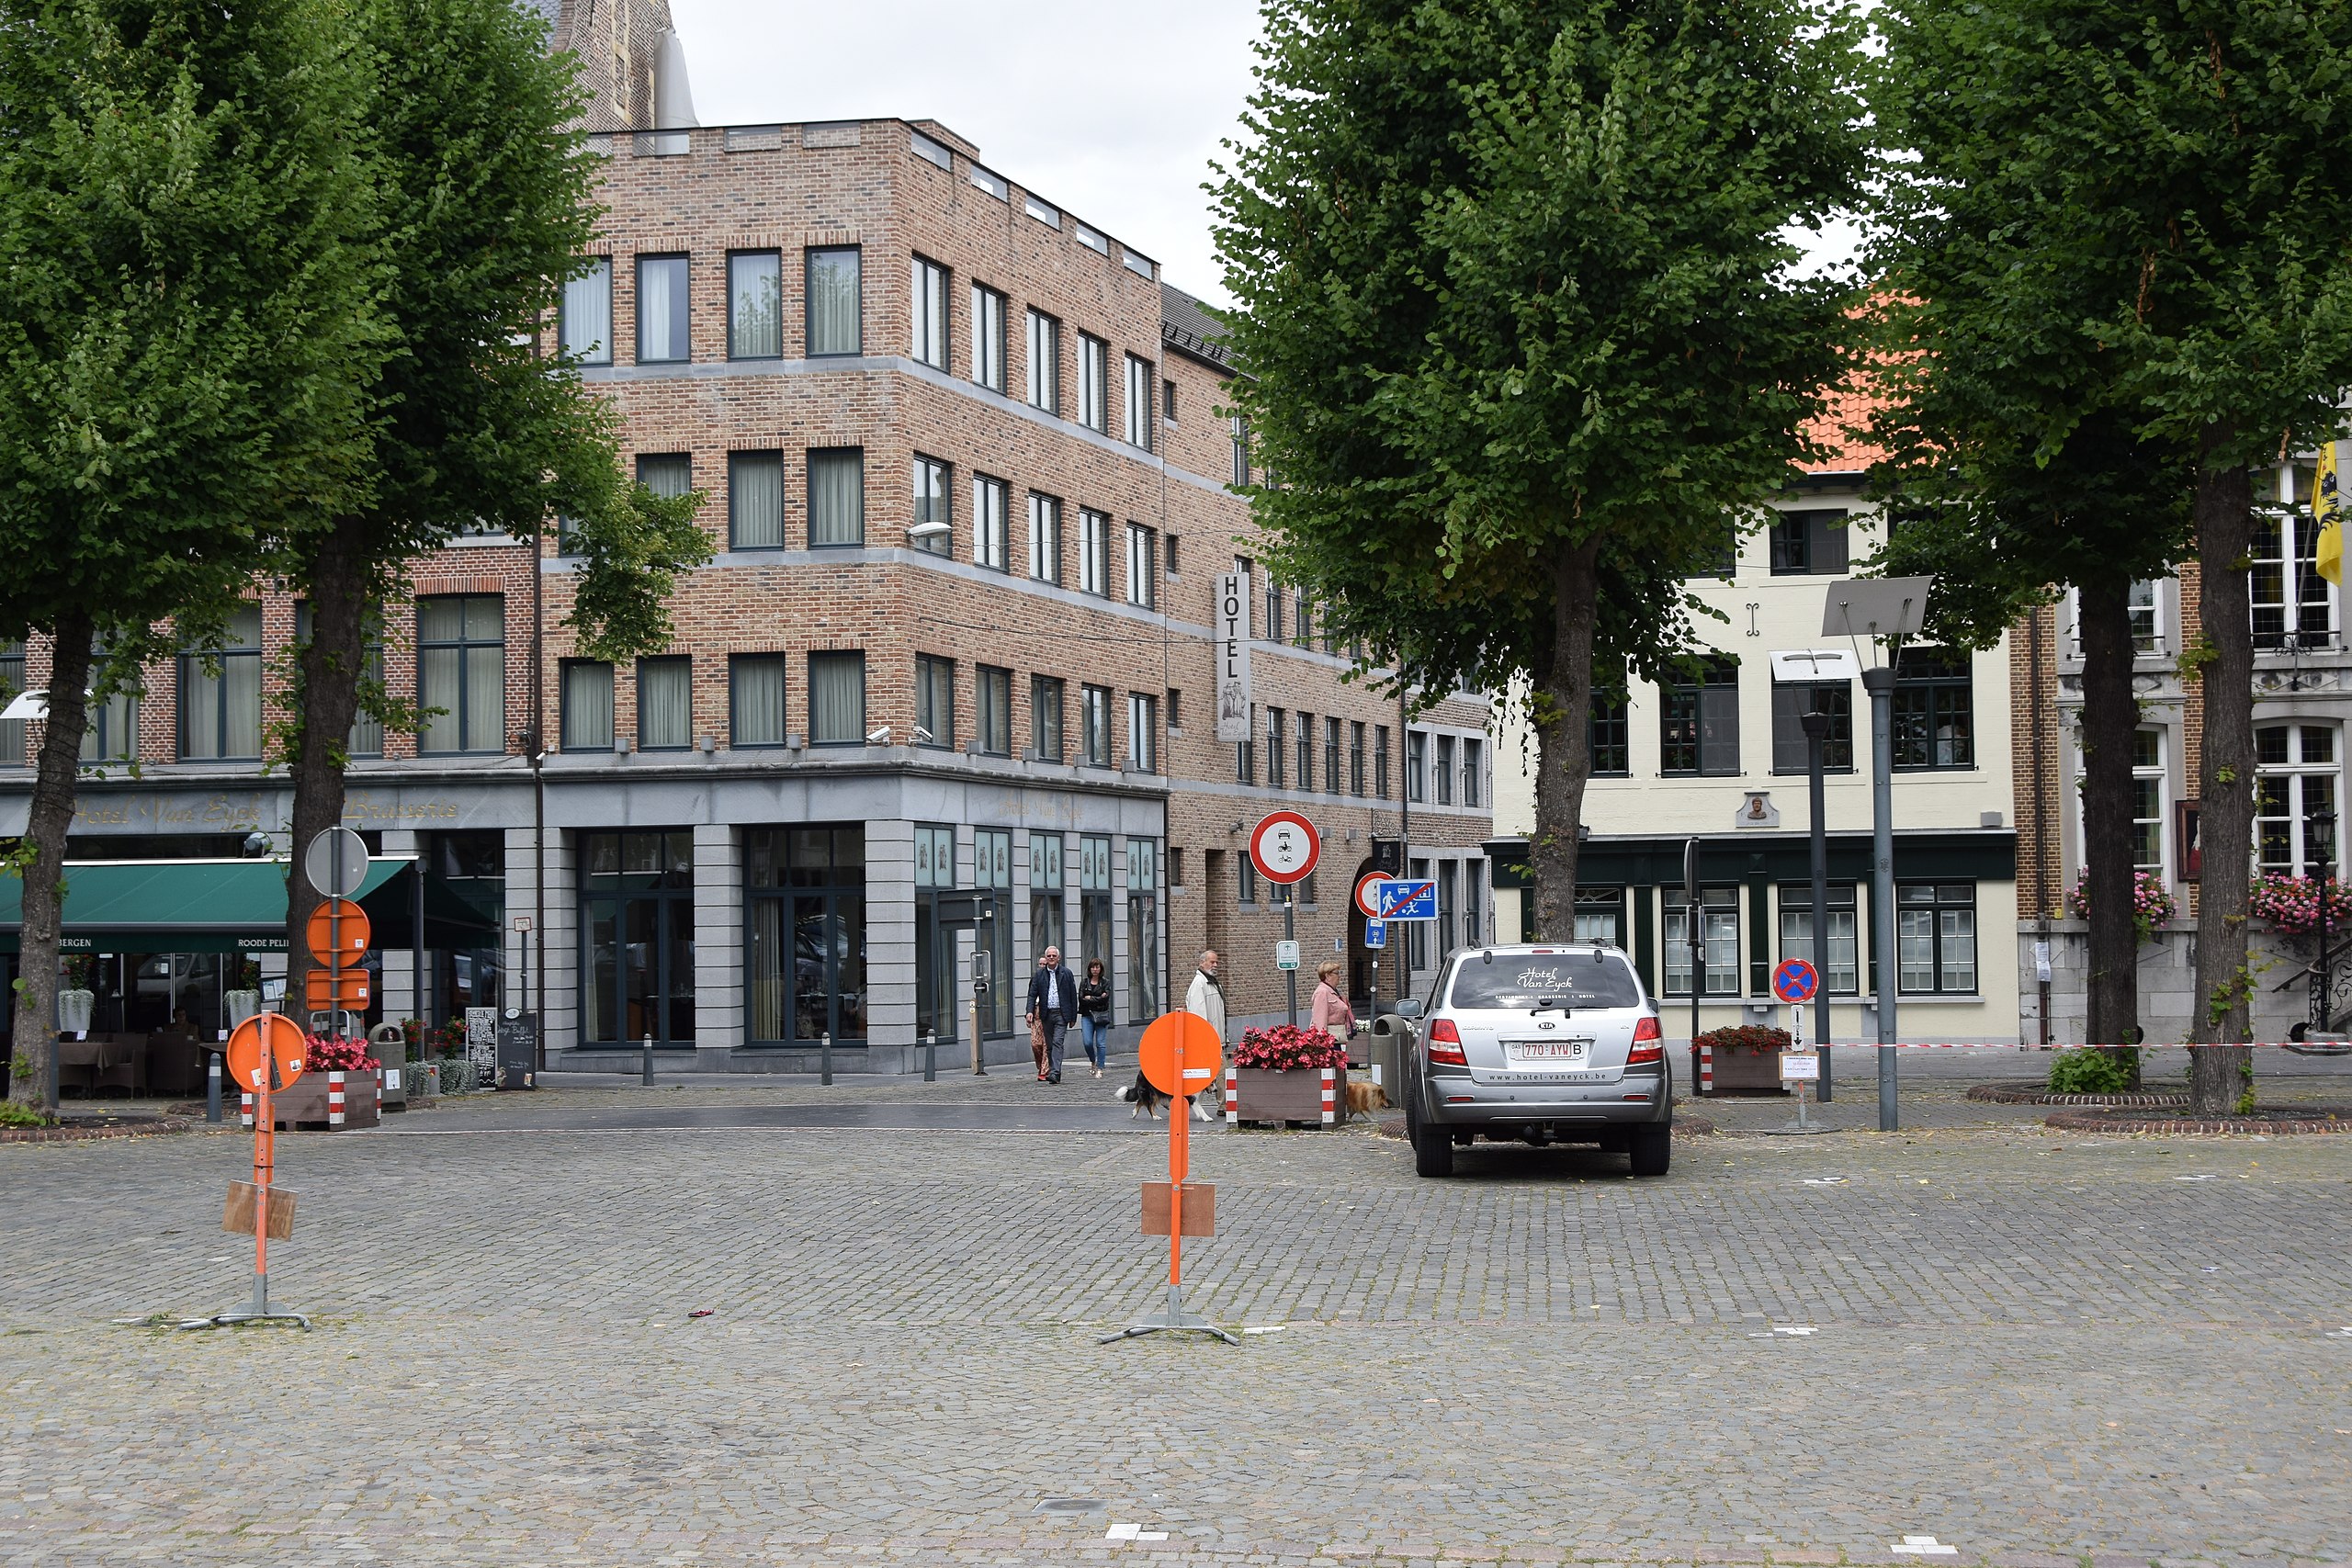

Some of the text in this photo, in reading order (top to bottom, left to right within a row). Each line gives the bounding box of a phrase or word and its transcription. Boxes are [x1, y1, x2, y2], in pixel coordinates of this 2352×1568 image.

[1224, 575, 1240, 679] HOTEL
[74, 790, 458, 832] Hotel Van Eyck Brasserie
[238, 939, 267, 947] ROODE
[1518, 967, 1558, 979] Hotel
[1517, 976, 1573, 992] Van Eyck
[1573, 1043, 1582, 1055] B
[1489, 1073, 1607, 1081] www.hotel-vaneyck.be
